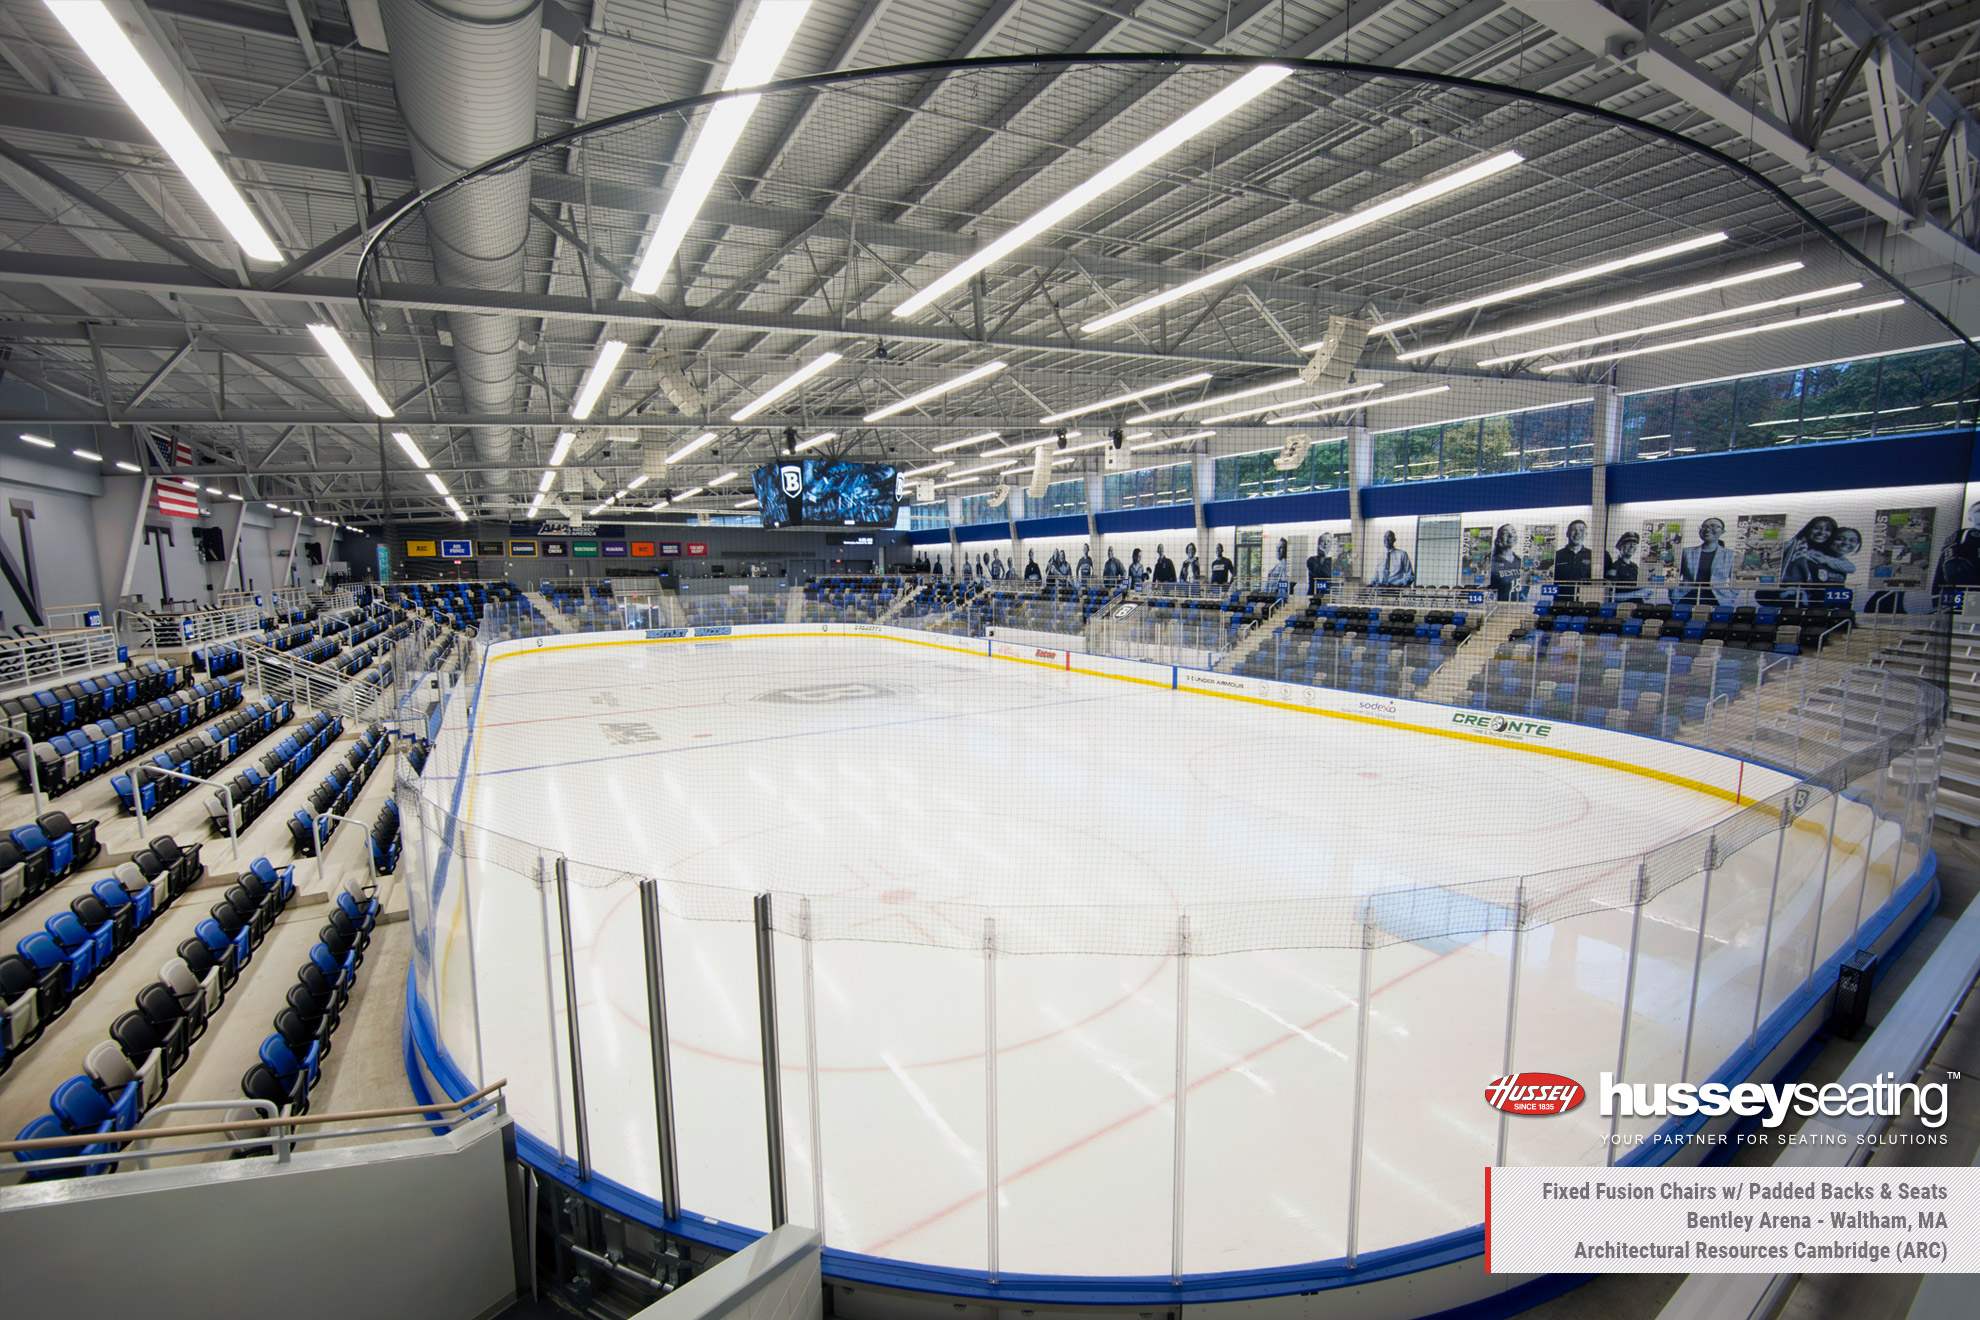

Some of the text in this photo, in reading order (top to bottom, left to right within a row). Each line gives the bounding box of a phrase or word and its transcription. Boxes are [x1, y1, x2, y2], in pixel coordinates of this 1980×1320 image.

[785, 472, 800, 491] B
[1542, 586, 1558, 594] 115
[1826, 591, 1850, 600] 115
[1469, 594, 1483, 602] 114
[89, 615, 101, 626] 103
[646, 627, 732, 639] BENTLEY FALCONS
[1195, 675, 1244, 689] UNDER ARMOUR
[1359, 701, 1397, 713] sodexo
